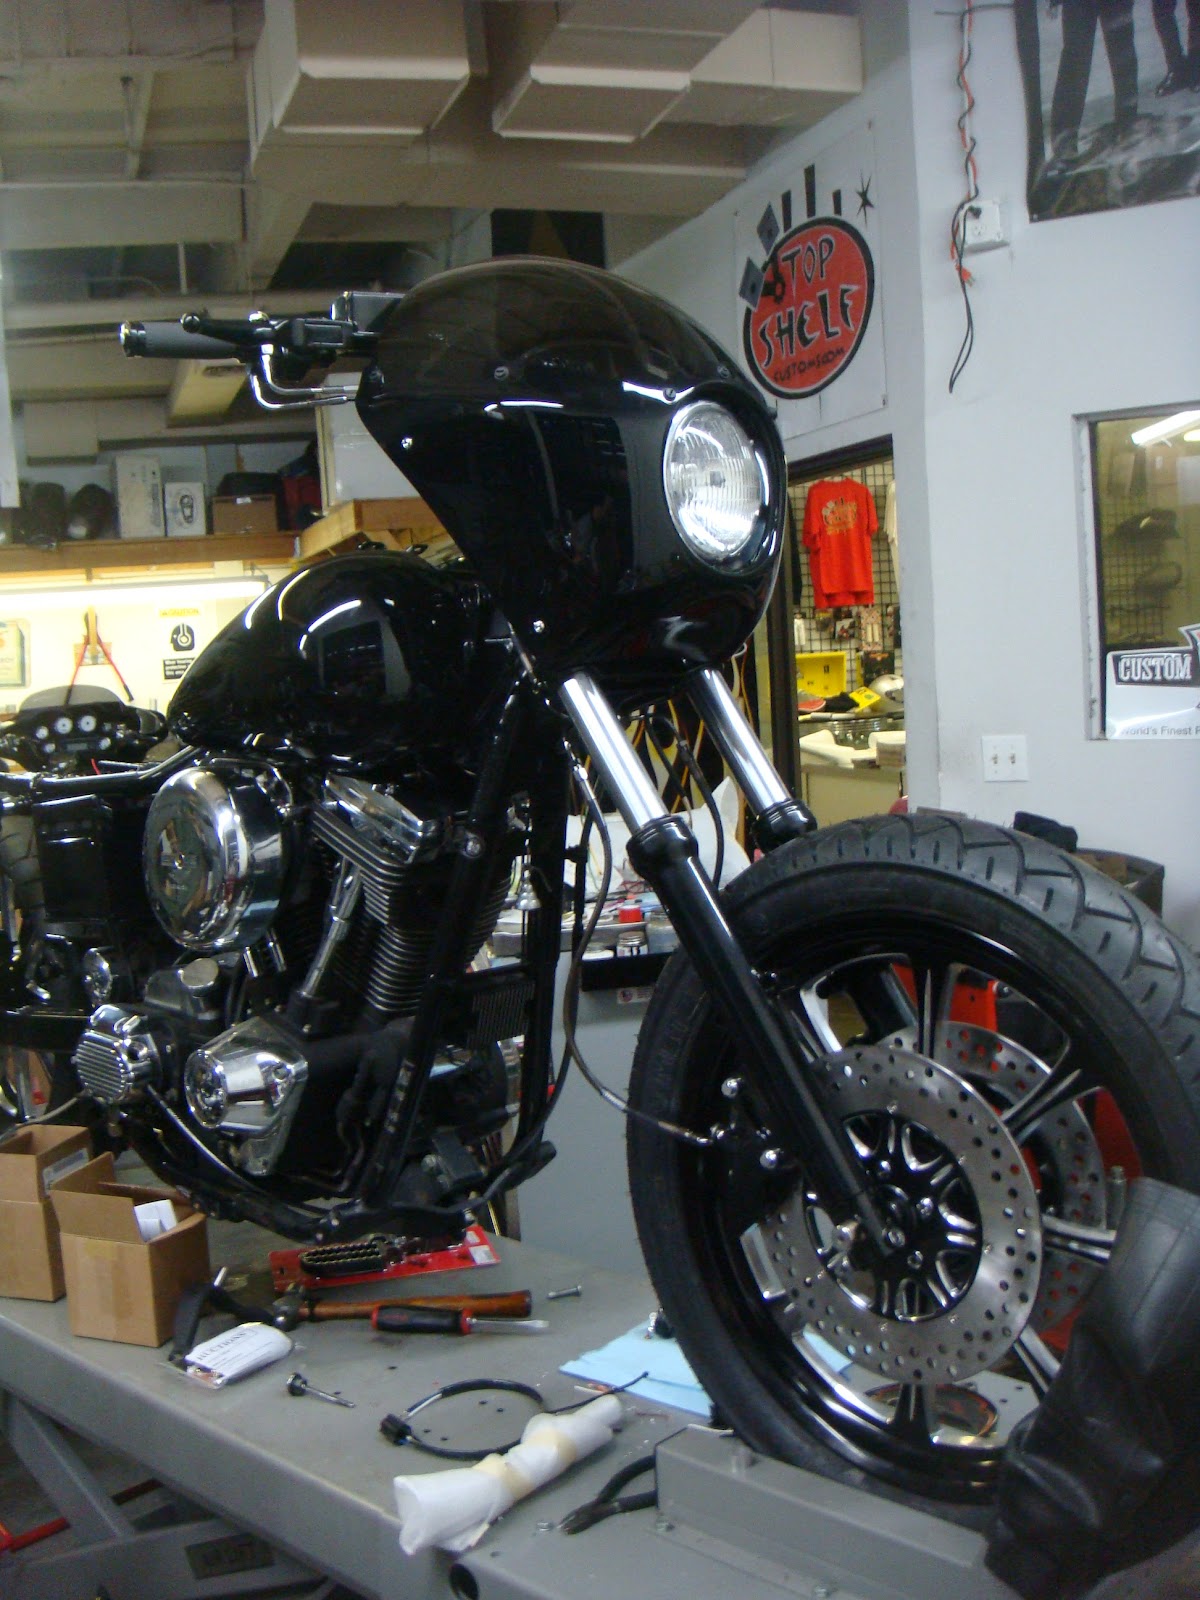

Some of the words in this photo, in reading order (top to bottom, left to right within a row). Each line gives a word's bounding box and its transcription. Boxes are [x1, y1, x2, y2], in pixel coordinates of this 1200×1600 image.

[781, 234, 835, 298] TOP
[758, 284, 860, 369] SHELF
[1118, 653, 1192, 682] CUSTOM
[1161, 725, 1192, 736] Finest
